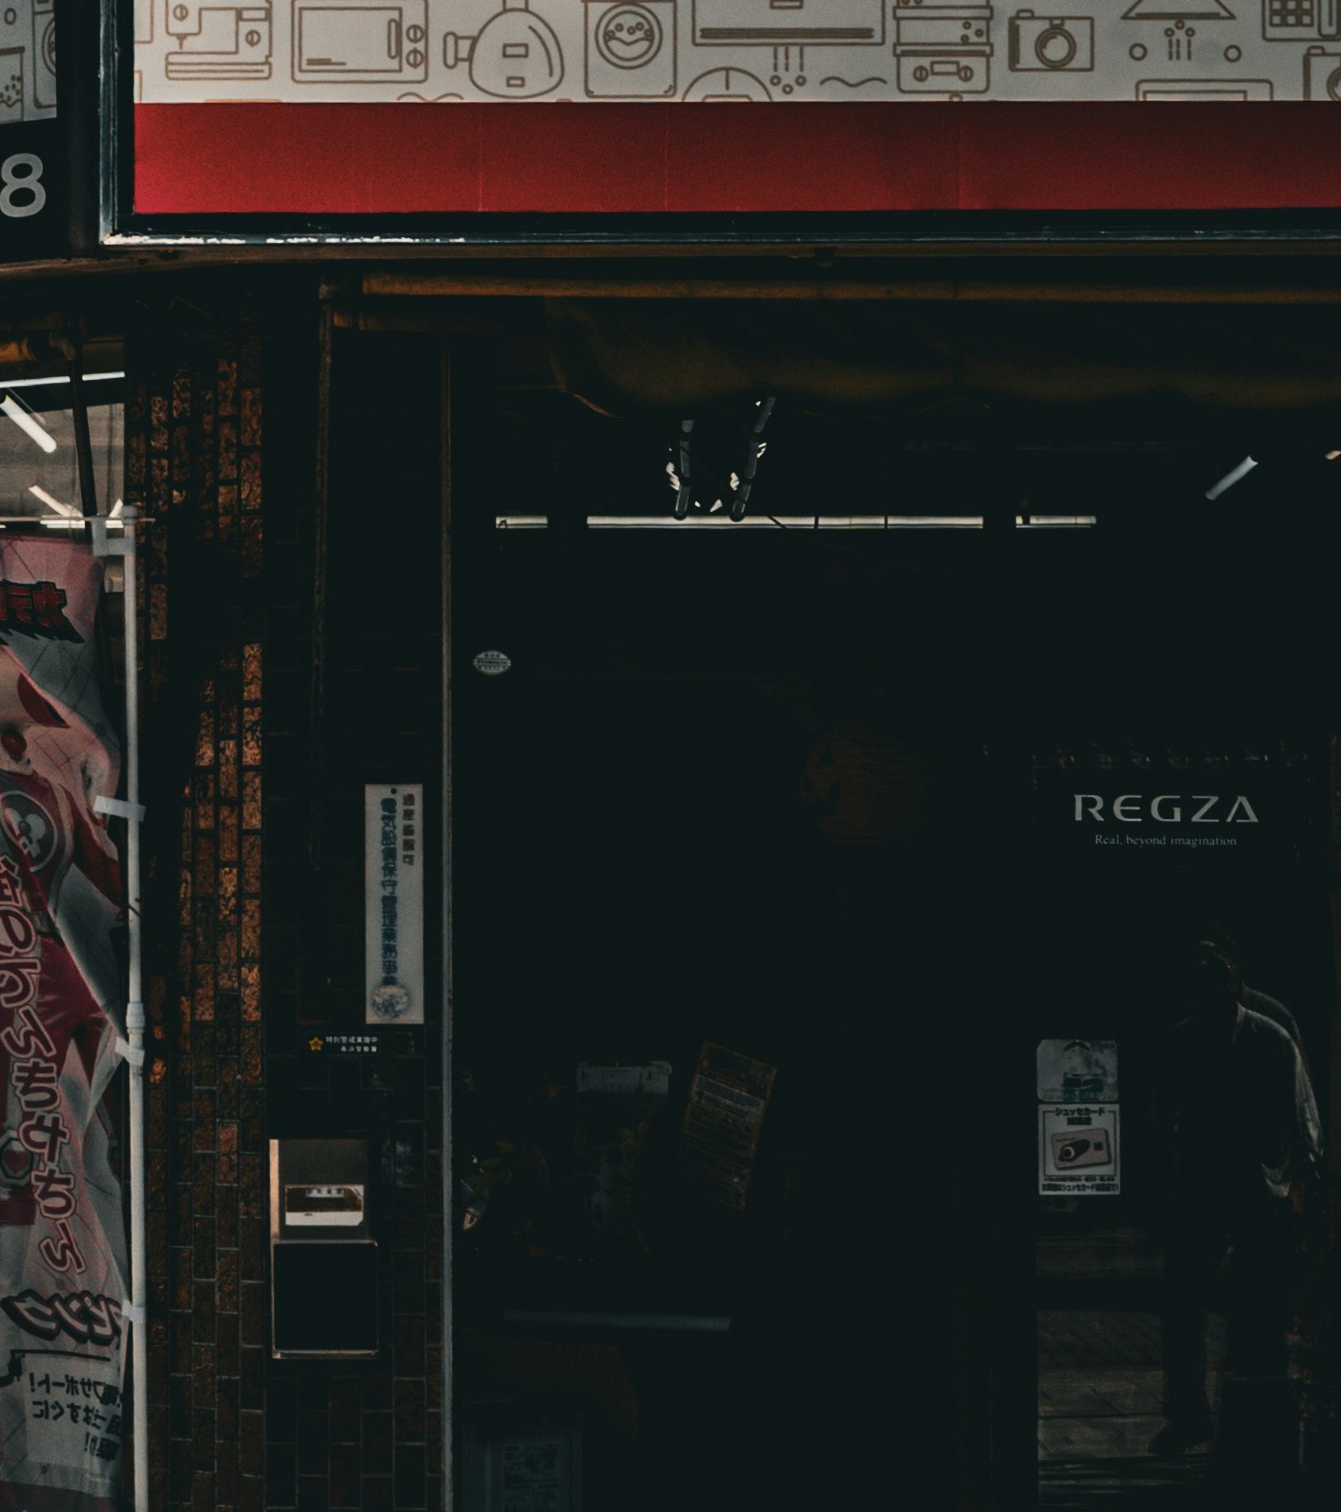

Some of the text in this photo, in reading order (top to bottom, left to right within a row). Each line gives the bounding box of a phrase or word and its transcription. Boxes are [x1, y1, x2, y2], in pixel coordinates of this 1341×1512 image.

[1074, 794, 1259, 822] REGZA
[1095, 834, 1237, 848] Real, beyond imagination
